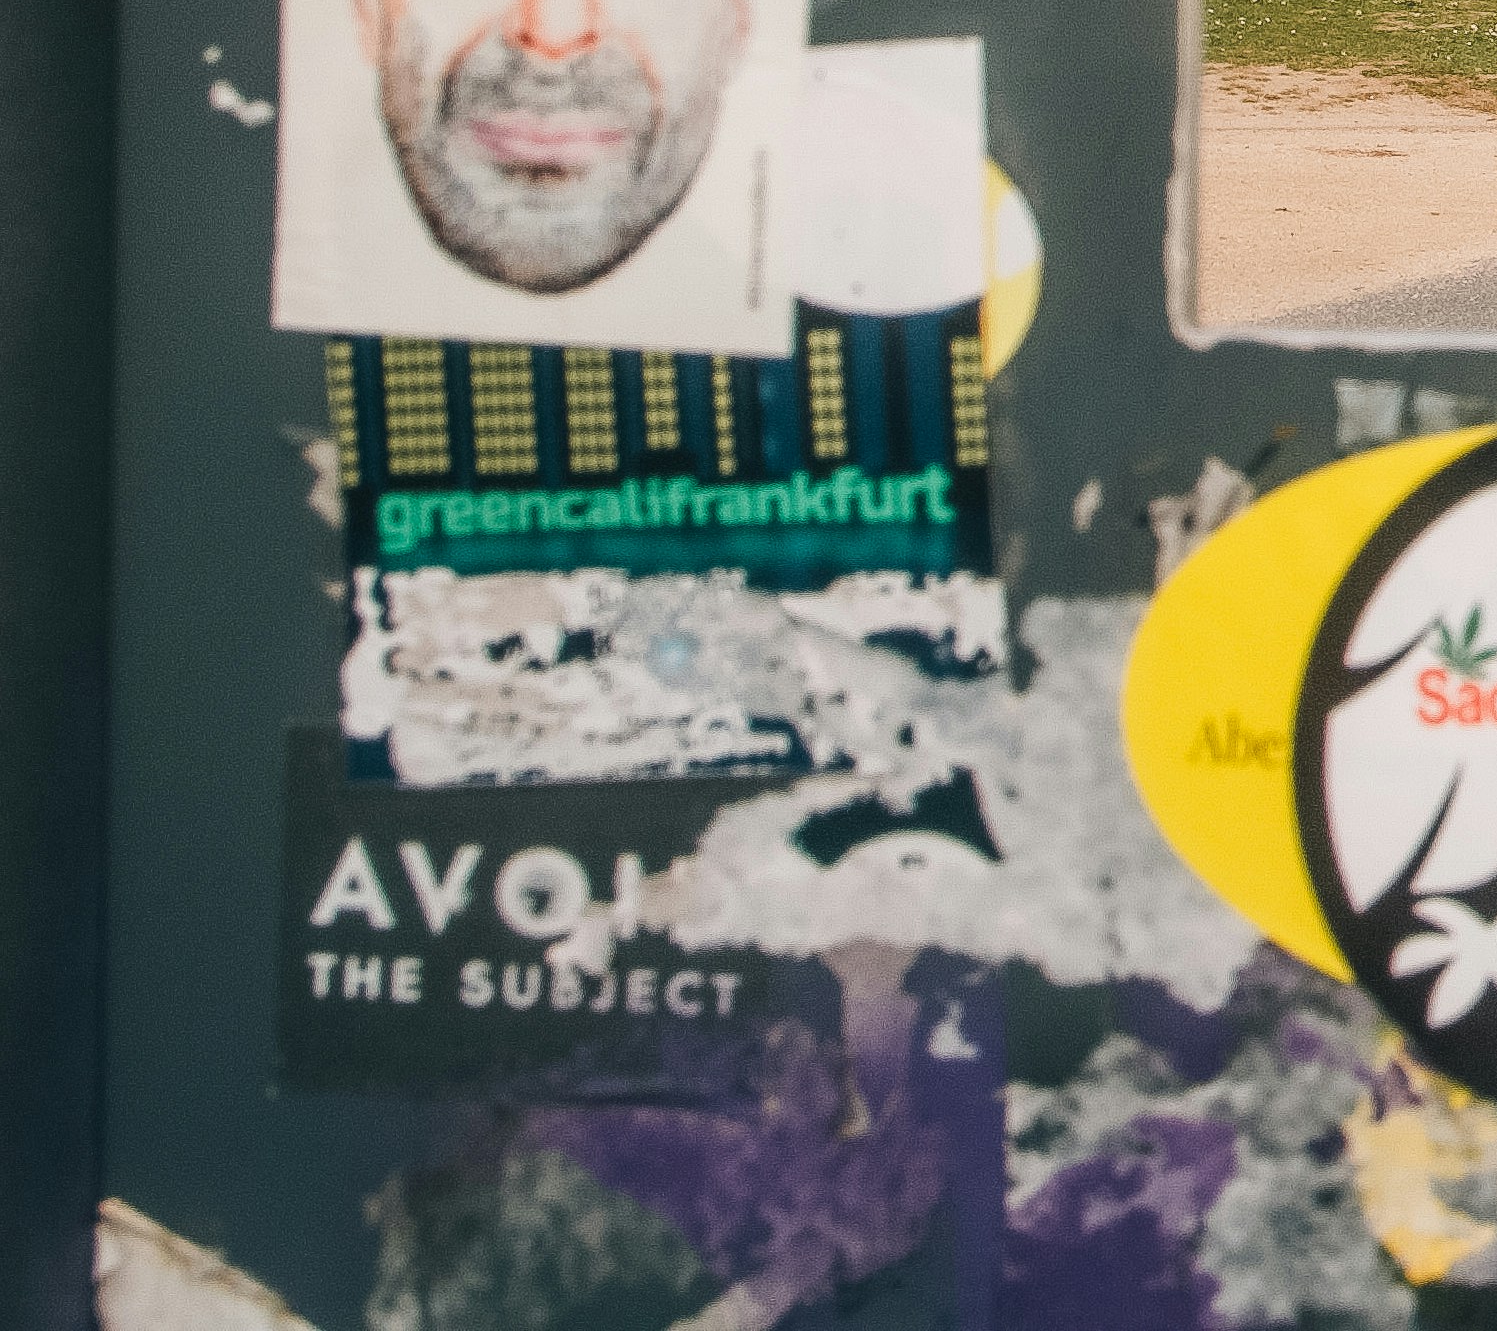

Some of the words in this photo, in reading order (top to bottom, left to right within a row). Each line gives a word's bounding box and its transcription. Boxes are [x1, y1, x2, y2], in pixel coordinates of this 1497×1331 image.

[376, 463, 956, 552] greencalifrankfurt
[1184, 710, 1294, 772] Abe
[307, 838, 650, 939] AVOI
[307, 950, 422, 1005] THE
[458, 952, 744, 1018] SUBJECT
